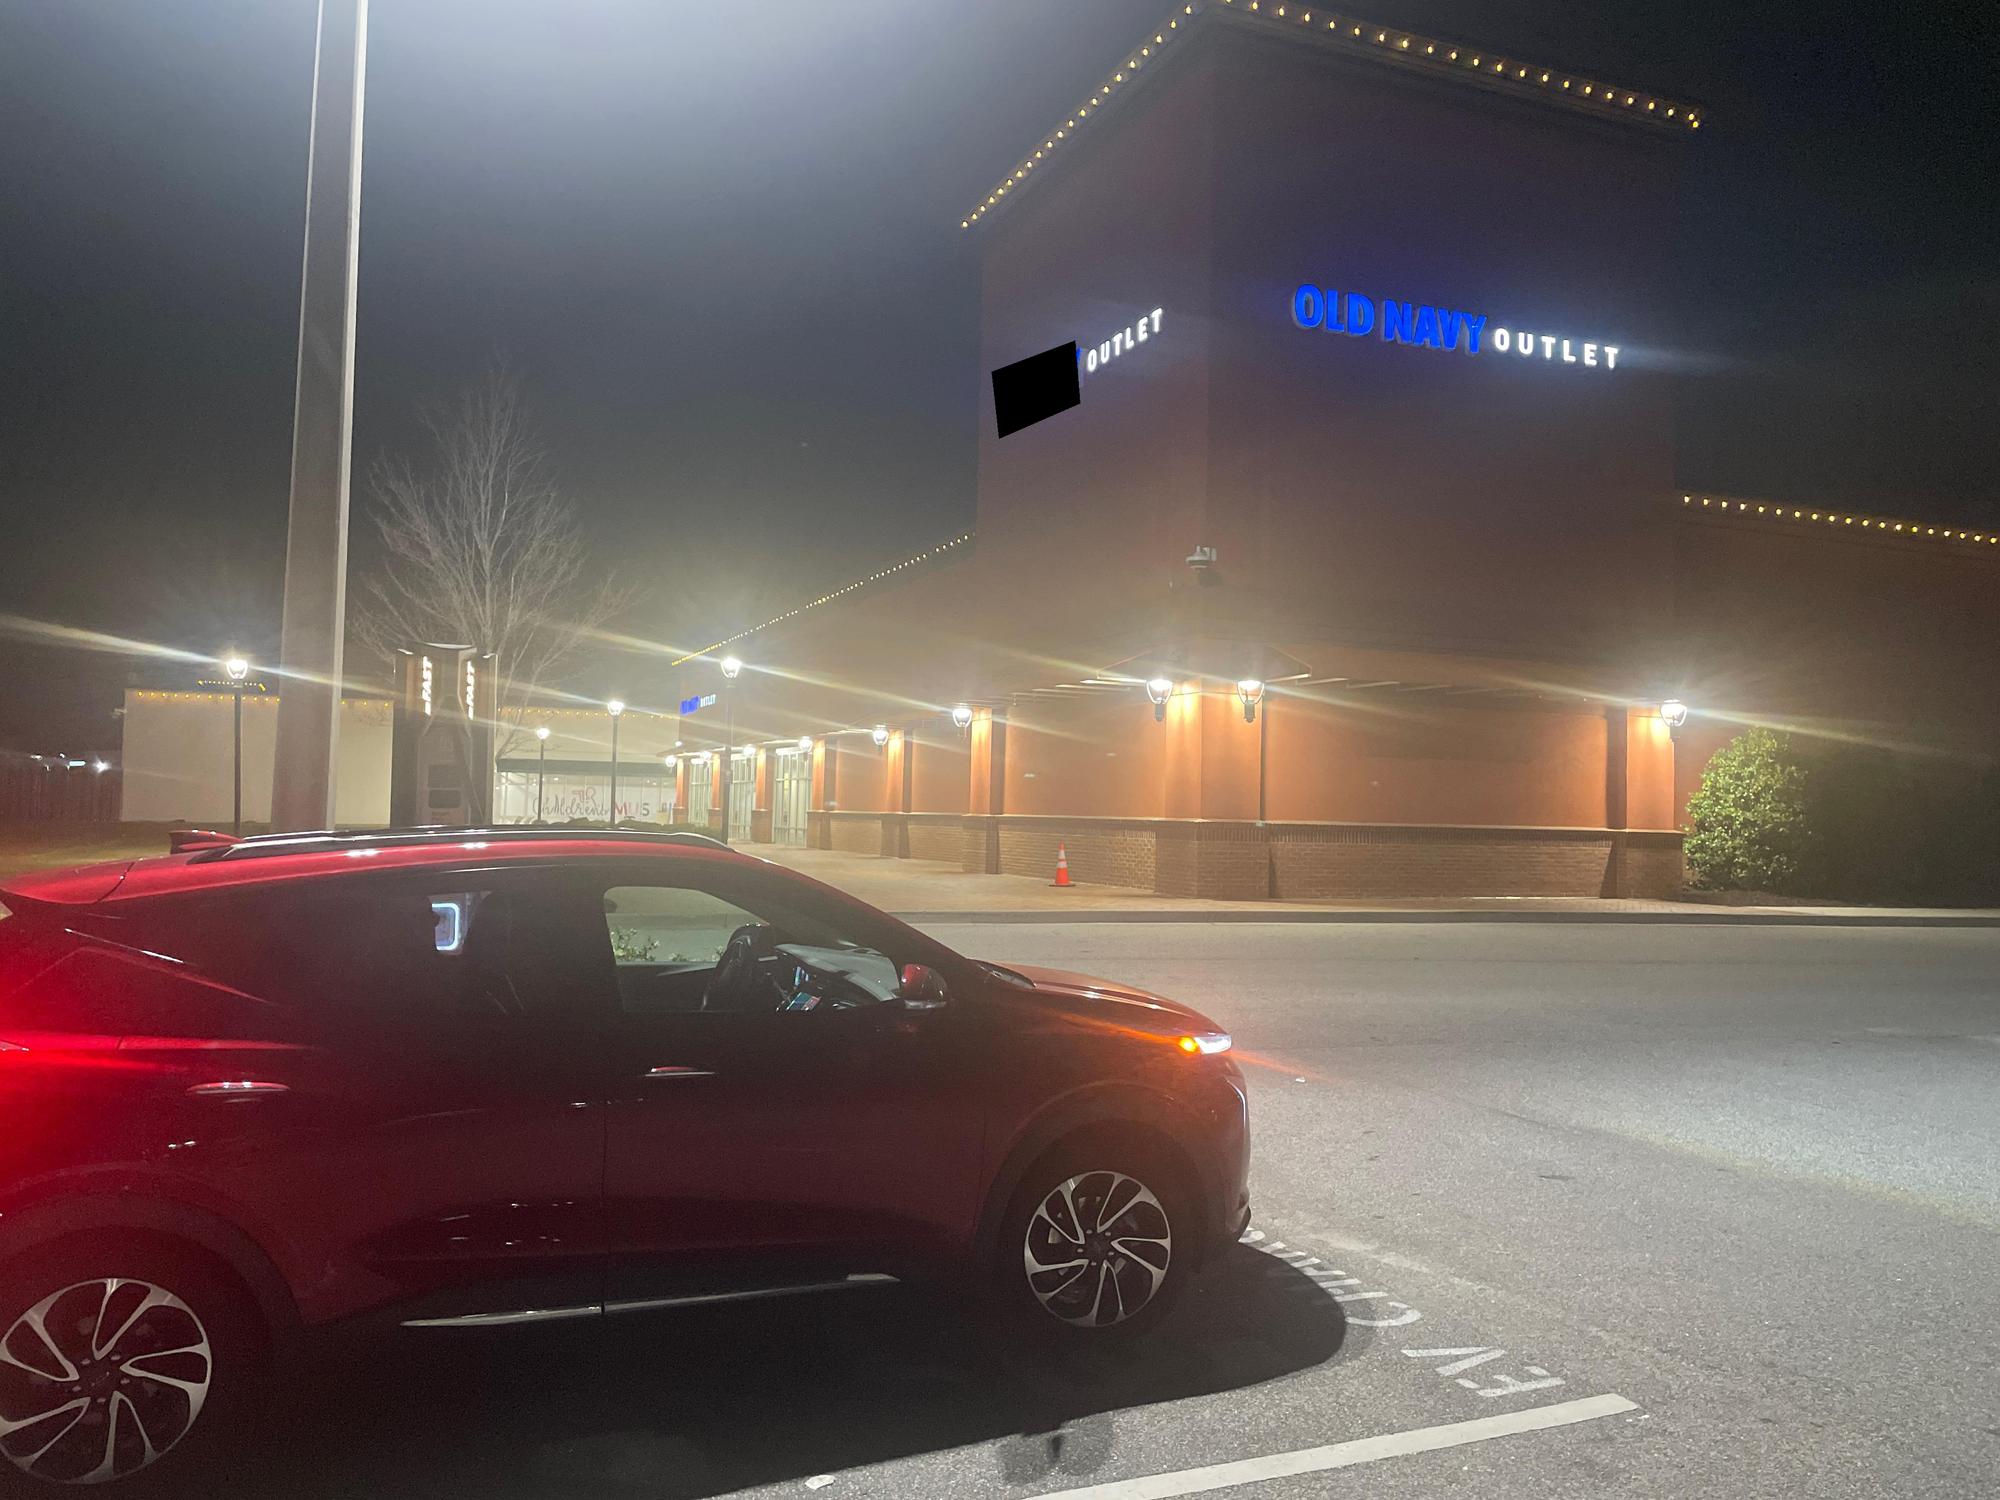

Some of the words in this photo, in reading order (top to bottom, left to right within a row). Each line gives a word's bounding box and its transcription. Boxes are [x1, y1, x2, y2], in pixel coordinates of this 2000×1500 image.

[1086, 306, 1164, 373] OUTLET
[1293, 283, 1375, 336] OLD
[1383, 299, 1488, 354] NAVY
[1493, 327, 1619, 369] OUTLET
